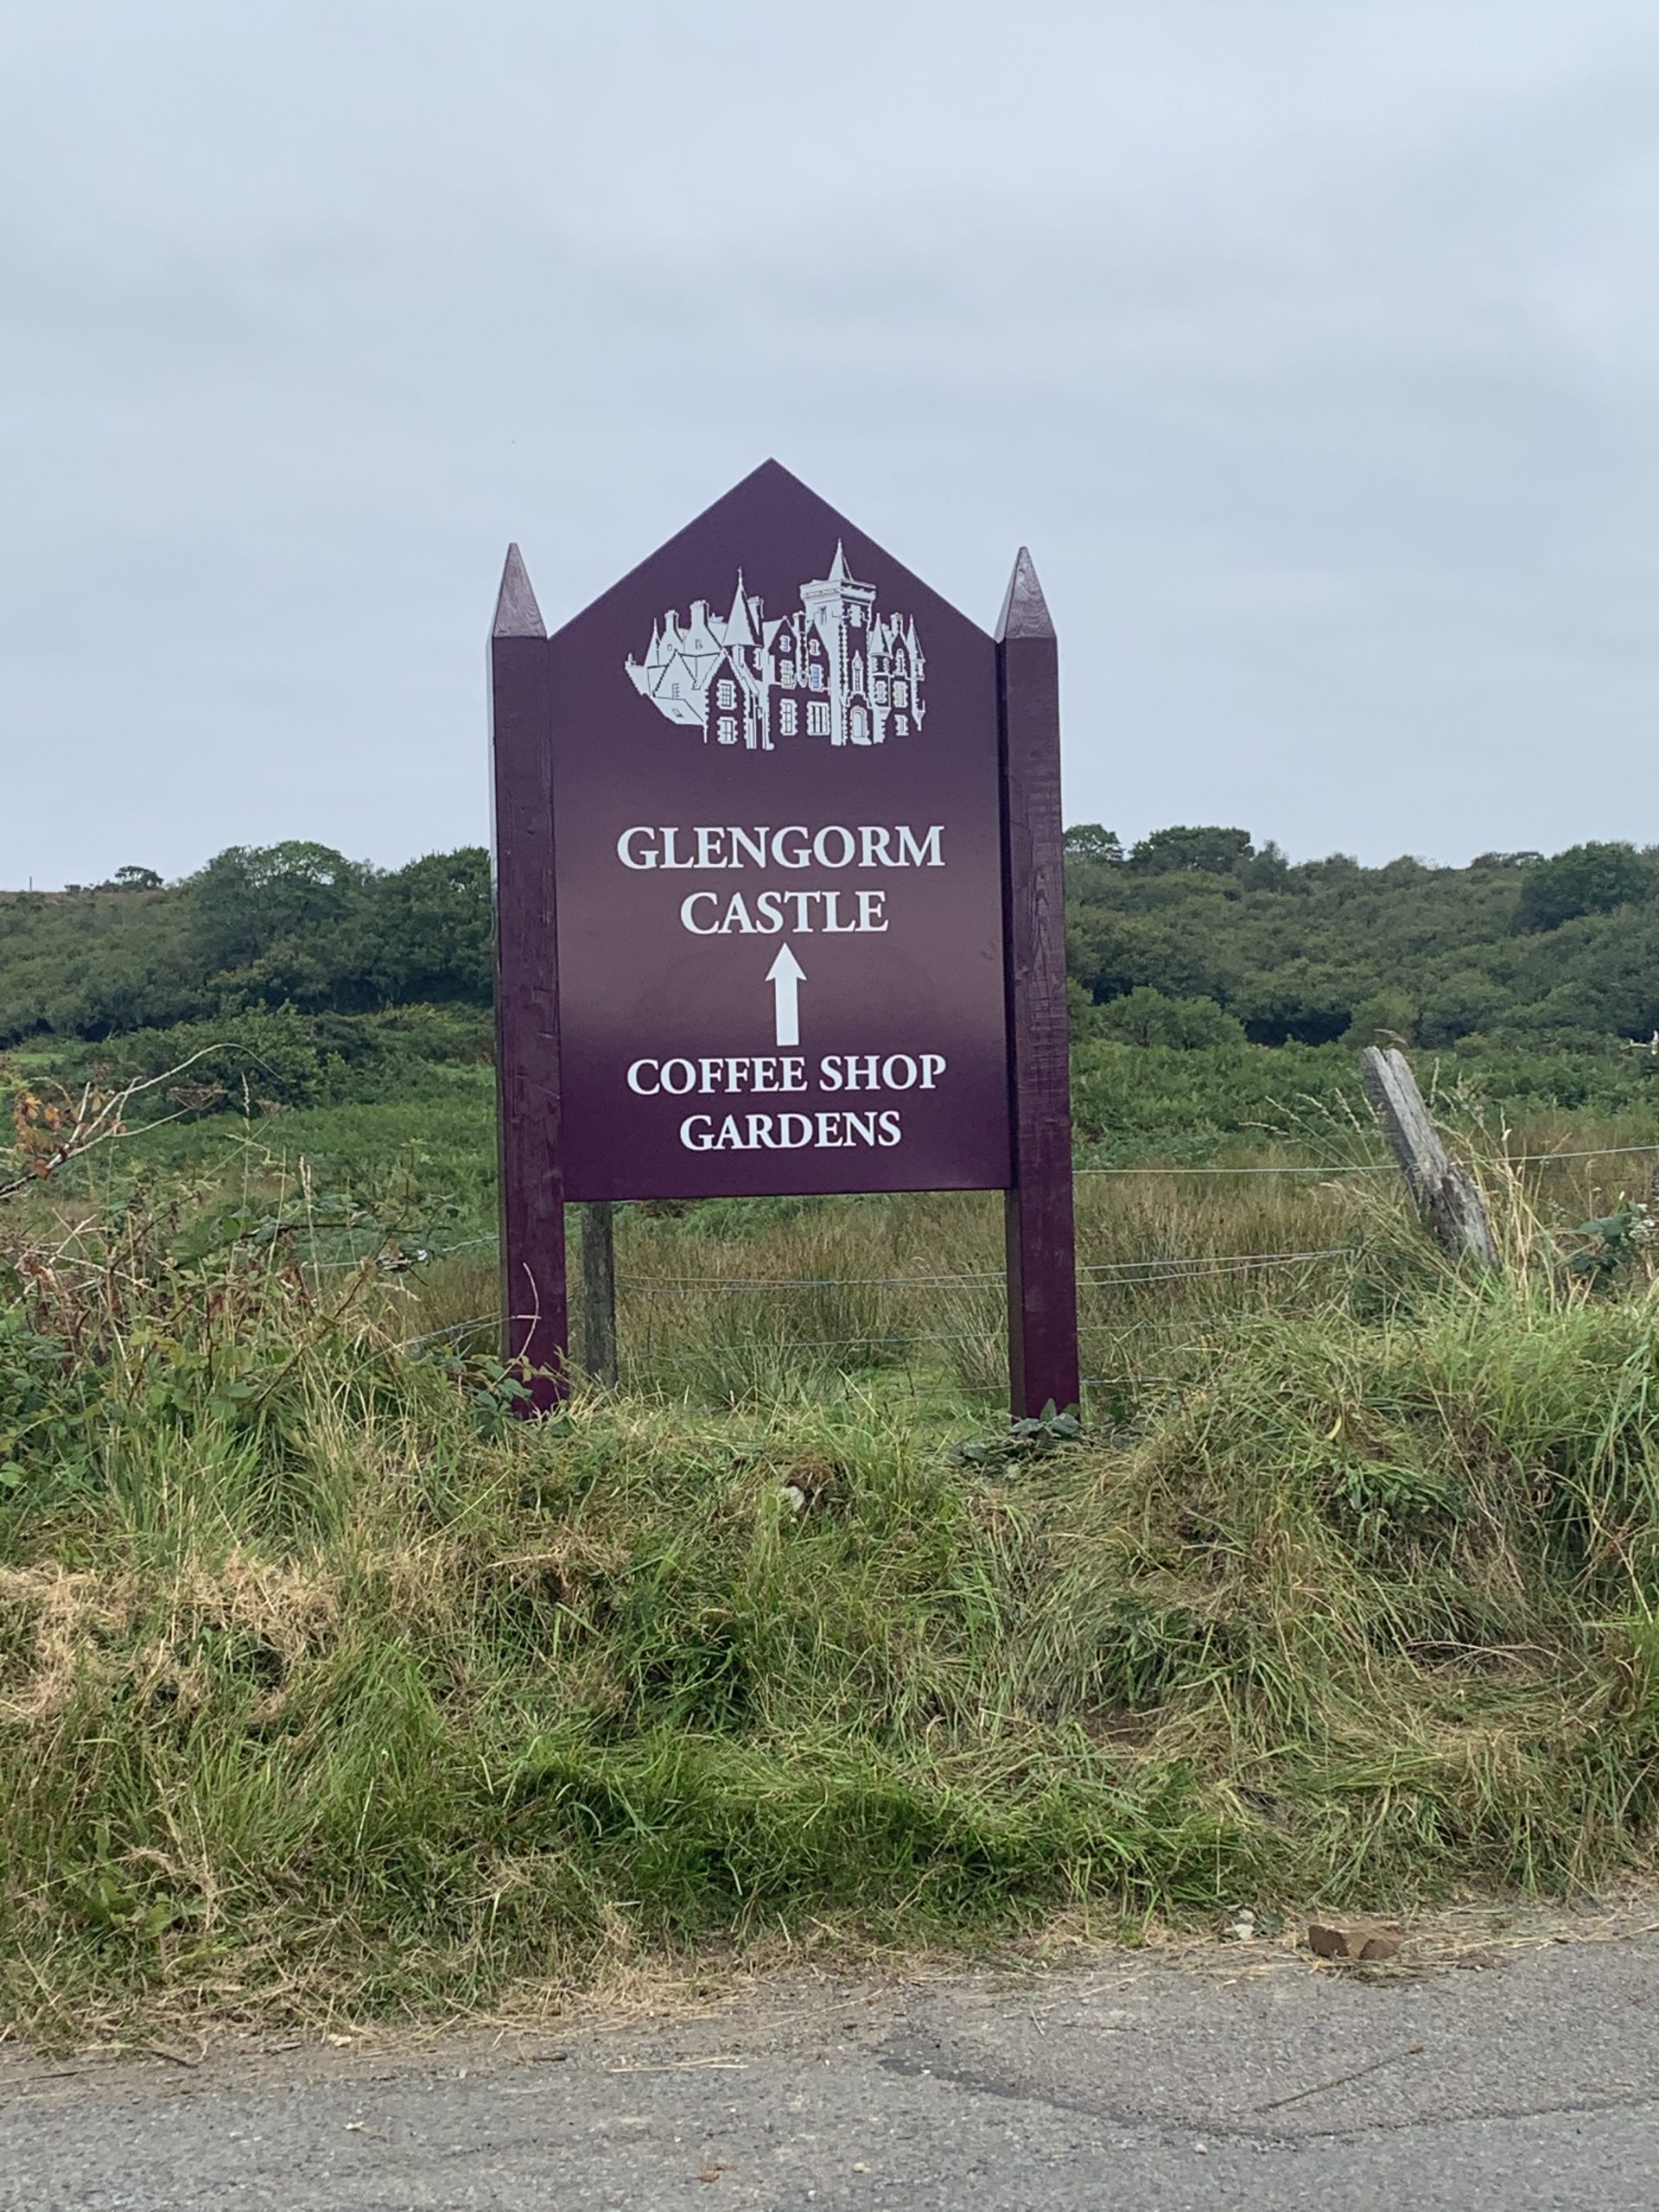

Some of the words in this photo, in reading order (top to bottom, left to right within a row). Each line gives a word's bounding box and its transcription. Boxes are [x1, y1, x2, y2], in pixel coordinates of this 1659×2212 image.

[617, 826, 946, 869] GLENGORM
[680, 891, 889, 935] CASTLE
[627, 1057, 808, 1095] COFFEE
[819, 1054, 946, 1091] SHOP
[680, 1110, 901, 1151] GARDENS
